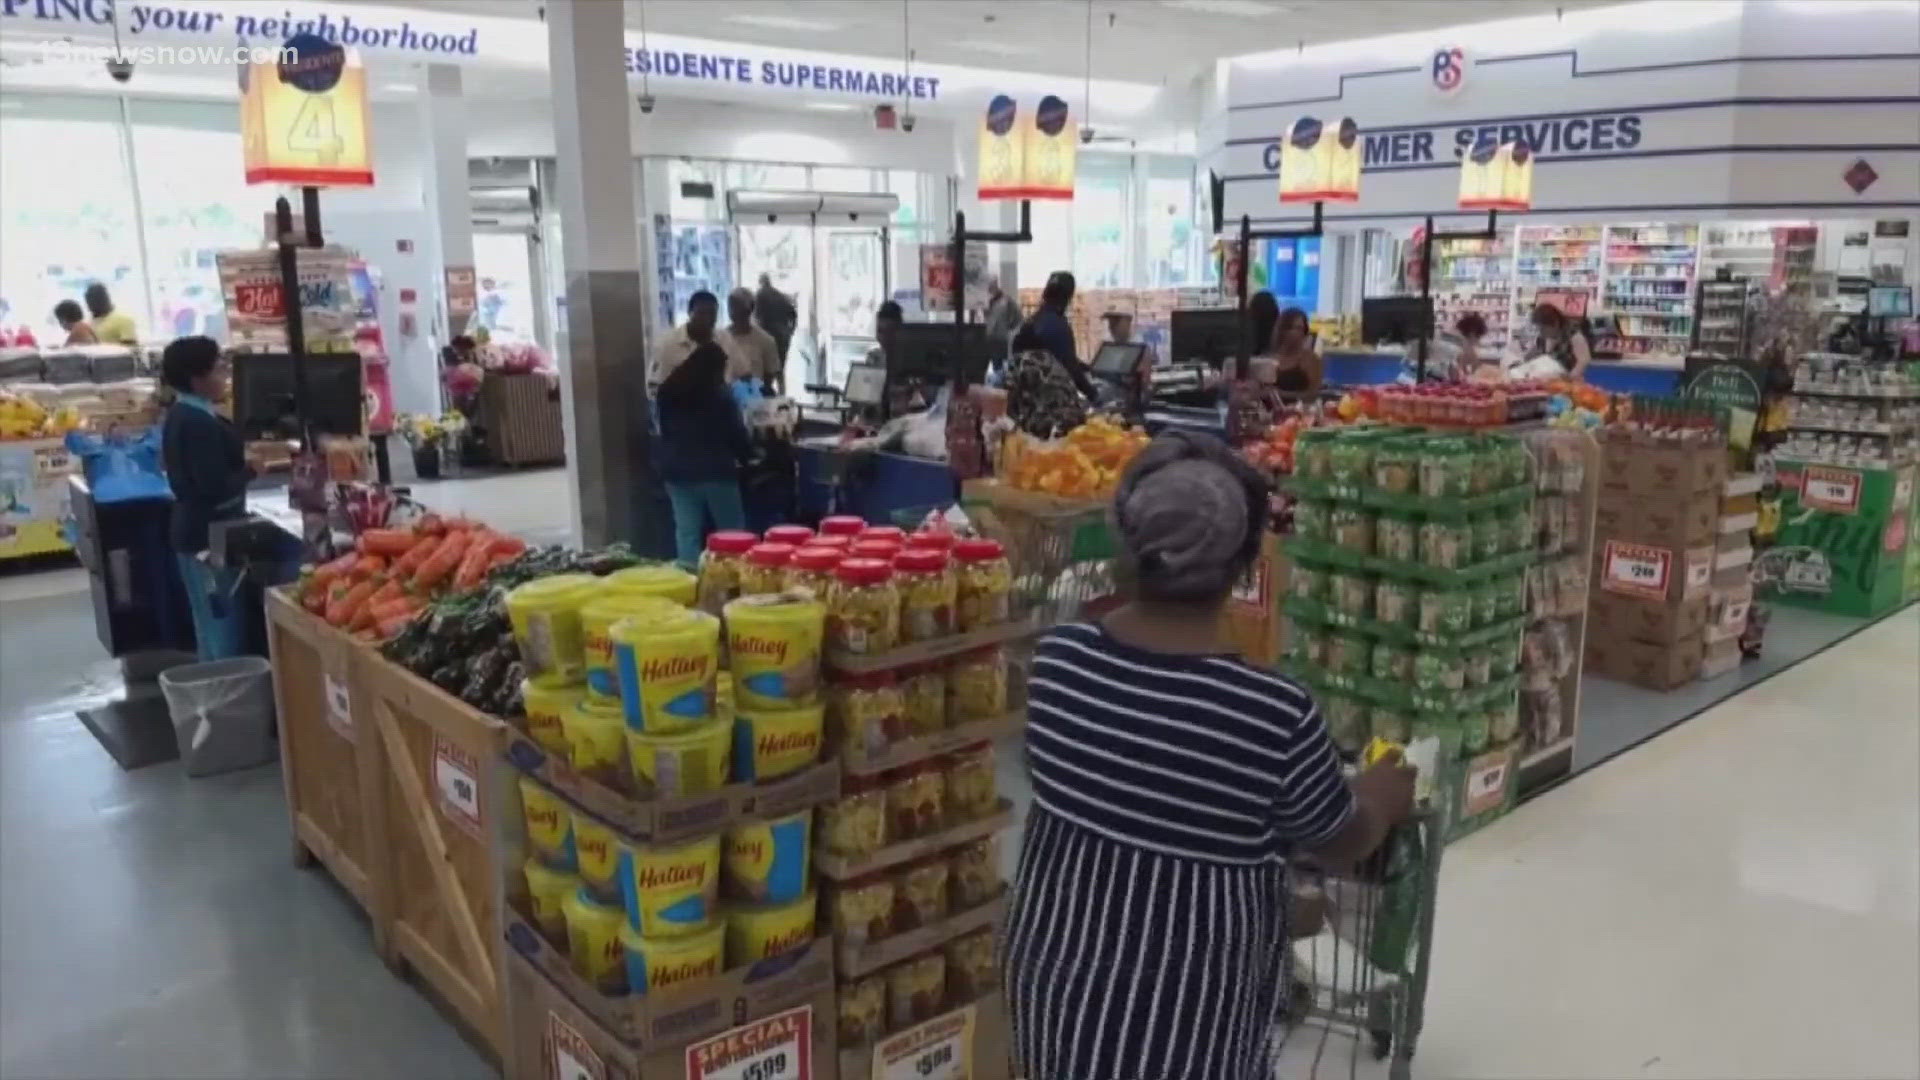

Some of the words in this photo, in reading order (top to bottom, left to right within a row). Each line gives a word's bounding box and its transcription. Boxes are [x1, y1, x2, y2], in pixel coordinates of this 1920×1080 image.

[130, 4, 223, 34] your
[235, 11, 477, 54] neighborhood
[762, 60, 939, 99] SUPERMARKET
[286, 94, 345, 164] 4
[731, 633, 790, 665] Hatuey
[641, 653, 710, 683] Hatuey
[758, 732, 817, 756] Hatuey
[639, 861, 706, 889] Hatuey
[650, 956, 717, 988] Hatuey
[697, 1015, 800, 1063] SPECIAL
